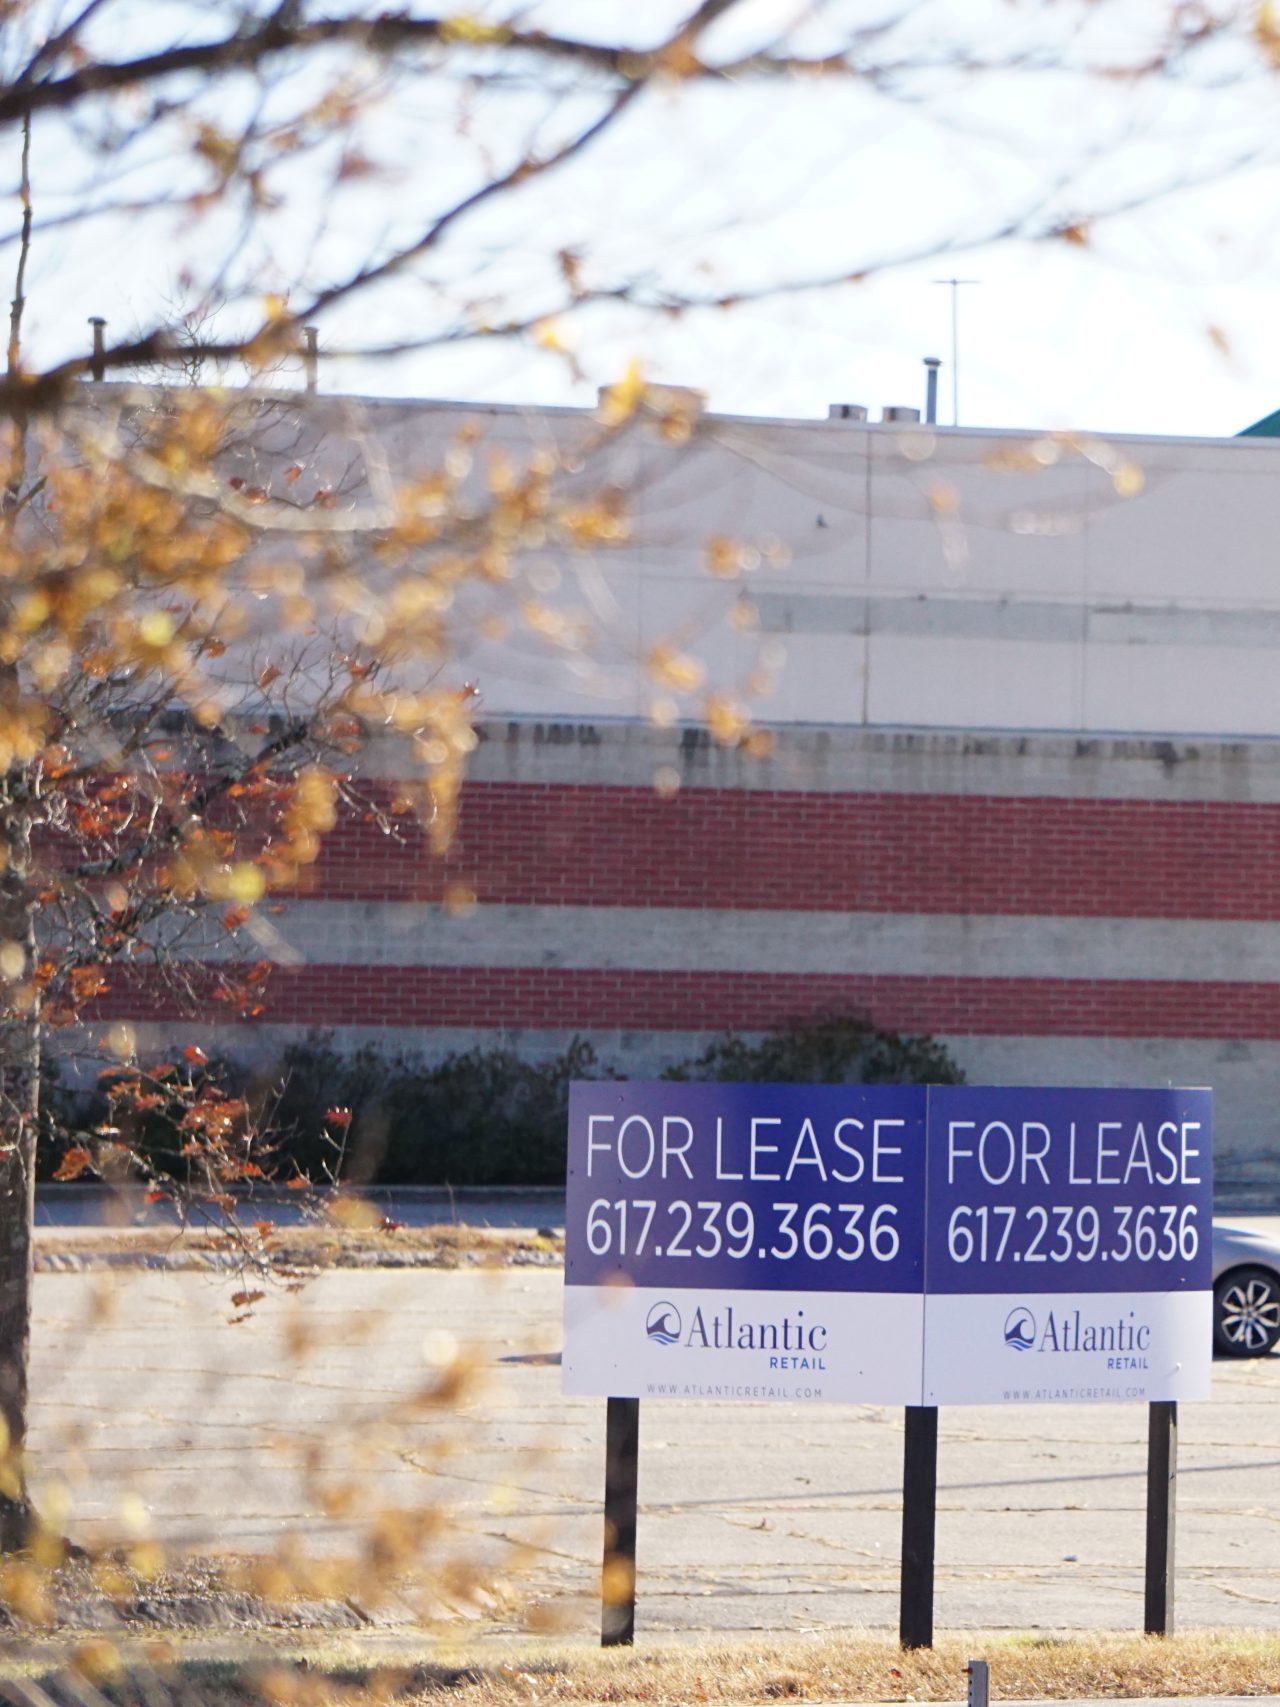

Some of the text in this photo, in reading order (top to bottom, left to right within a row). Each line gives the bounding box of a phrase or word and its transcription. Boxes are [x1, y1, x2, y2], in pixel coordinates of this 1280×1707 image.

[587, 1115, 905, 1183] FOR LEASE
[948, 1121, 1201, 1185] FOR LEASE
[586, 1198, 900, 1262] 617.239.3636
[948, 1205, 1198, 1263] 617.239.3636
[683, 1304, 828, 1351] Atlantic
[1037, 1309, 1150, 1353] Atlantic
[769, 1356, 827, 1371] RETAIL
[1107, 1357, 1149, 1370] RETAIL
[646, 1383, 823, 1399] WWW.ATLANTICRETAIL.COM
[1002, 1387, 1146, 1401] WWW.ATLANTICRETAIL.COM
